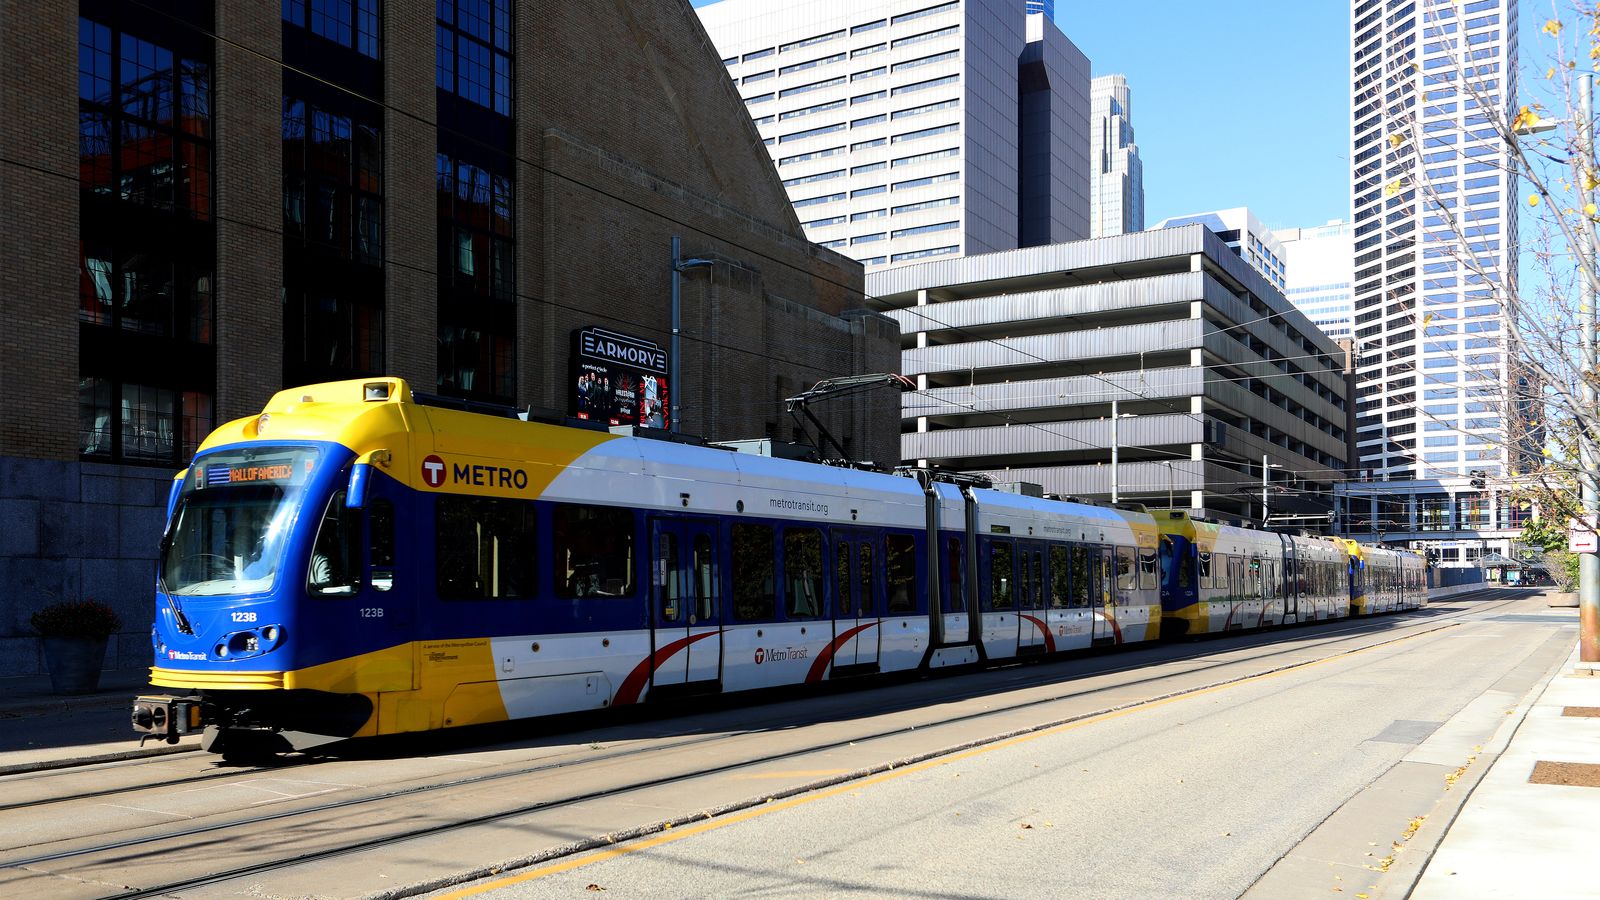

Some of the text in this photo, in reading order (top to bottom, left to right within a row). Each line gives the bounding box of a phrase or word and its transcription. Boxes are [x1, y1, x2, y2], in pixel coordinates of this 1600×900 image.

[595, 340, 656, 367] ARMORY
[424, 461, 529, 490] T METRO
[769, 498, 829, 516] metrotransit.org
[230, 612, 257, 622] 123B
[359, 608, 384, 618] 123B
